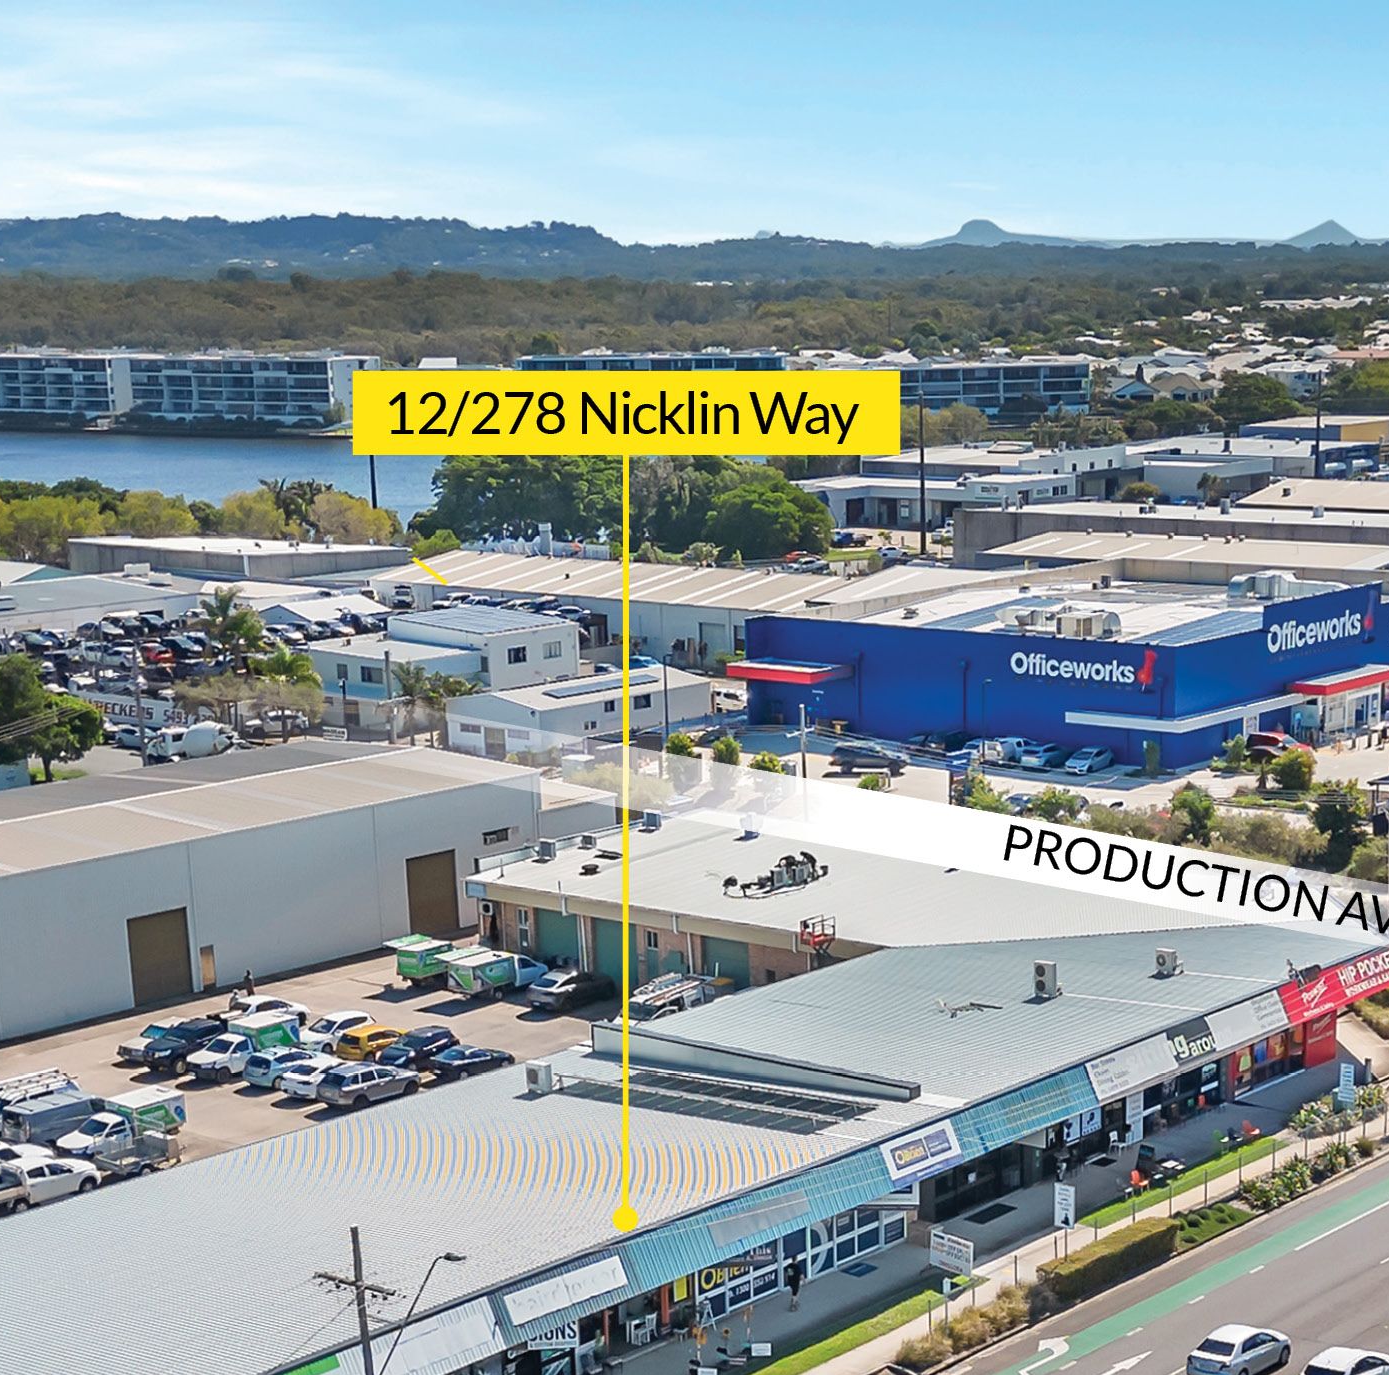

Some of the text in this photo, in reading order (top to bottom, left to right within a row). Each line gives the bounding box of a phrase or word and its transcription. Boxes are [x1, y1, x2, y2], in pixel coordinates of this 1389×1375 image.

[1267, 609, 1361, 653] Officeworks
[1010, 651, 1135, 684] Officeworks
[89, 699, 154, 720] RECKERS
[1337, 965, 1357, 987] HIP
[529, 1319, 577, 1342] IGNS
